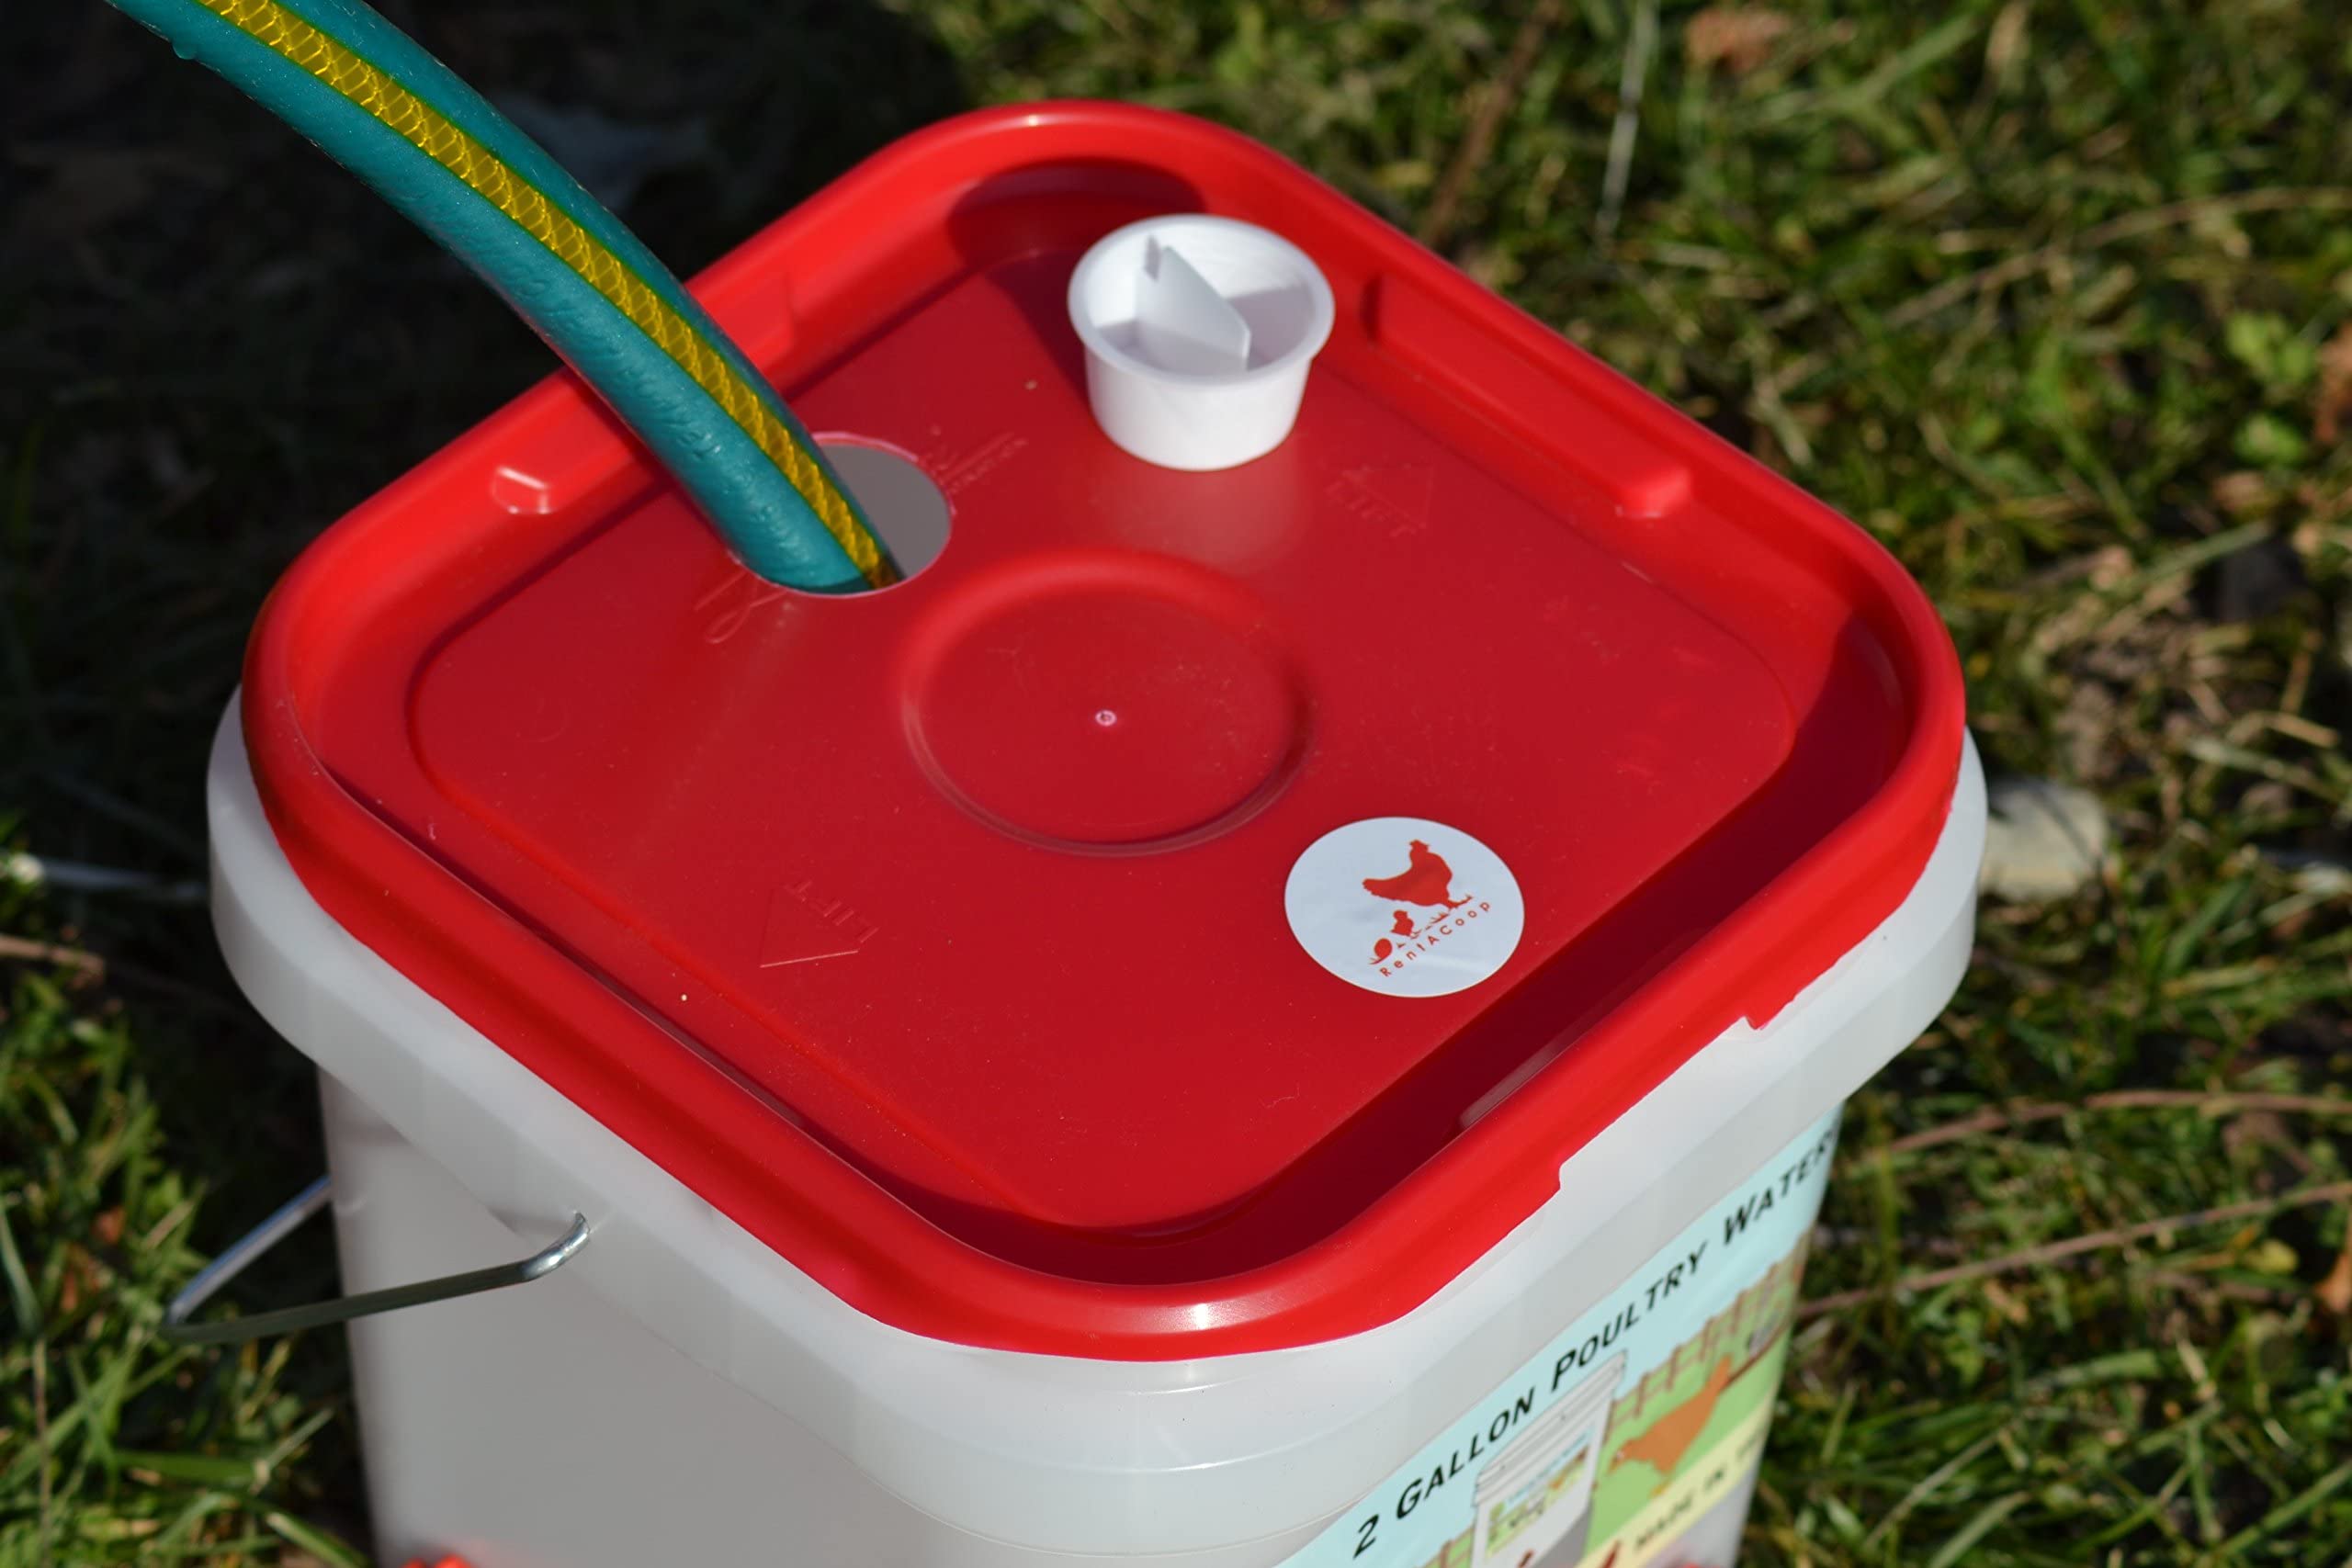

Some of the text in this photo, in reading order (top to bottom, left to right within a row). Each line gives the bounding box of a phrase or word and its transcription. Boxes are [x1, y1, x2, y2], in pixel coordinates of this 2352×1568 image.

[1379, 901, 1491, 977] RentACoop
[1352, 1513, 1380, 1561] 2
[1396, 1386, 1536, 1520] GALLON
[1551, 1241, 1709, 1393] POULTRY
